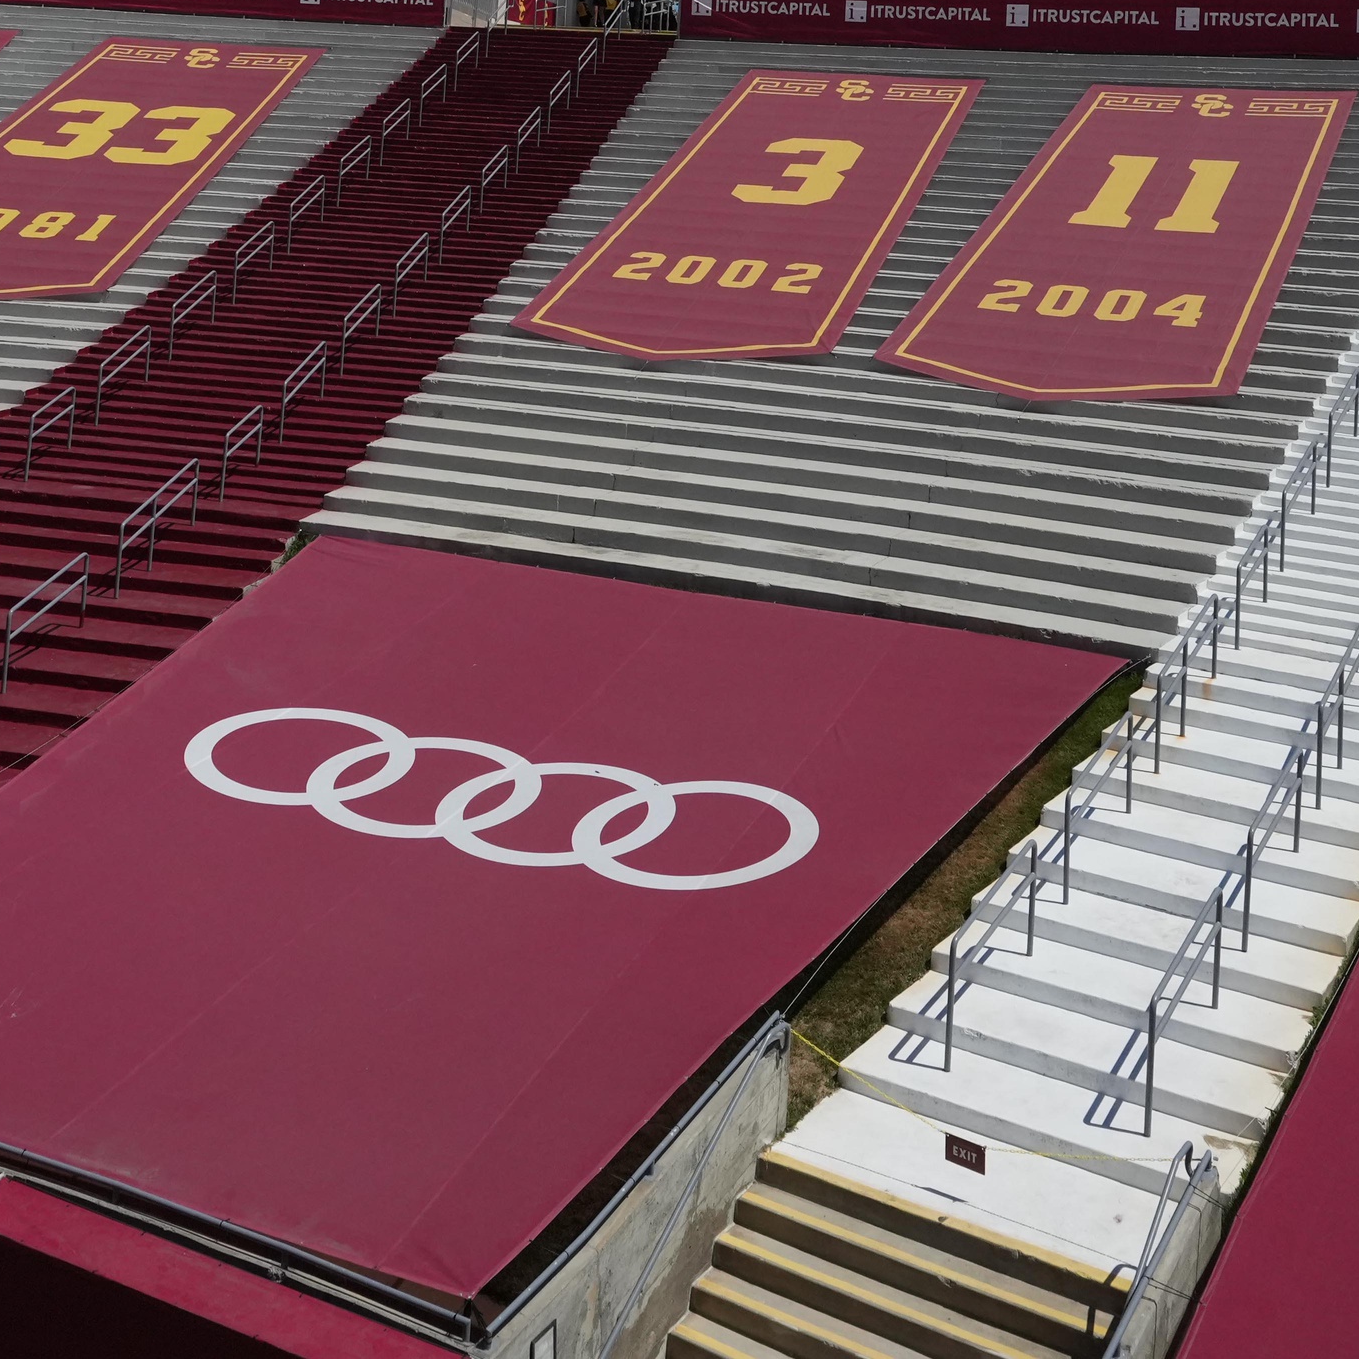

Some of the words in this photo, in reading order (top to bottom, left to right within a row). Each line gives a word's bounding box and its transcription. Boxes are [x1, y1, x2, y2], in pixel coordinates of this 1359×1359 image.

[715, 0, 831, 17] ITRUSTCAPITAL
[870, 4, 991, 21] ITRUSTCAPITAL
[1032, 8, 1160, 25] ITRUSTCAPITAL
[1203, 12, 1339, 28] ITRUSTCAPITAL
[5, 98, 236, 166] 33
[732, 137, 864, 206] 3
[1069, 154, 1240, 233] 11
[613, 251, 823, 294] 2002
[979, 279, 1206, 327] 2004
[952, 1144, 978, 1164] EXIT
